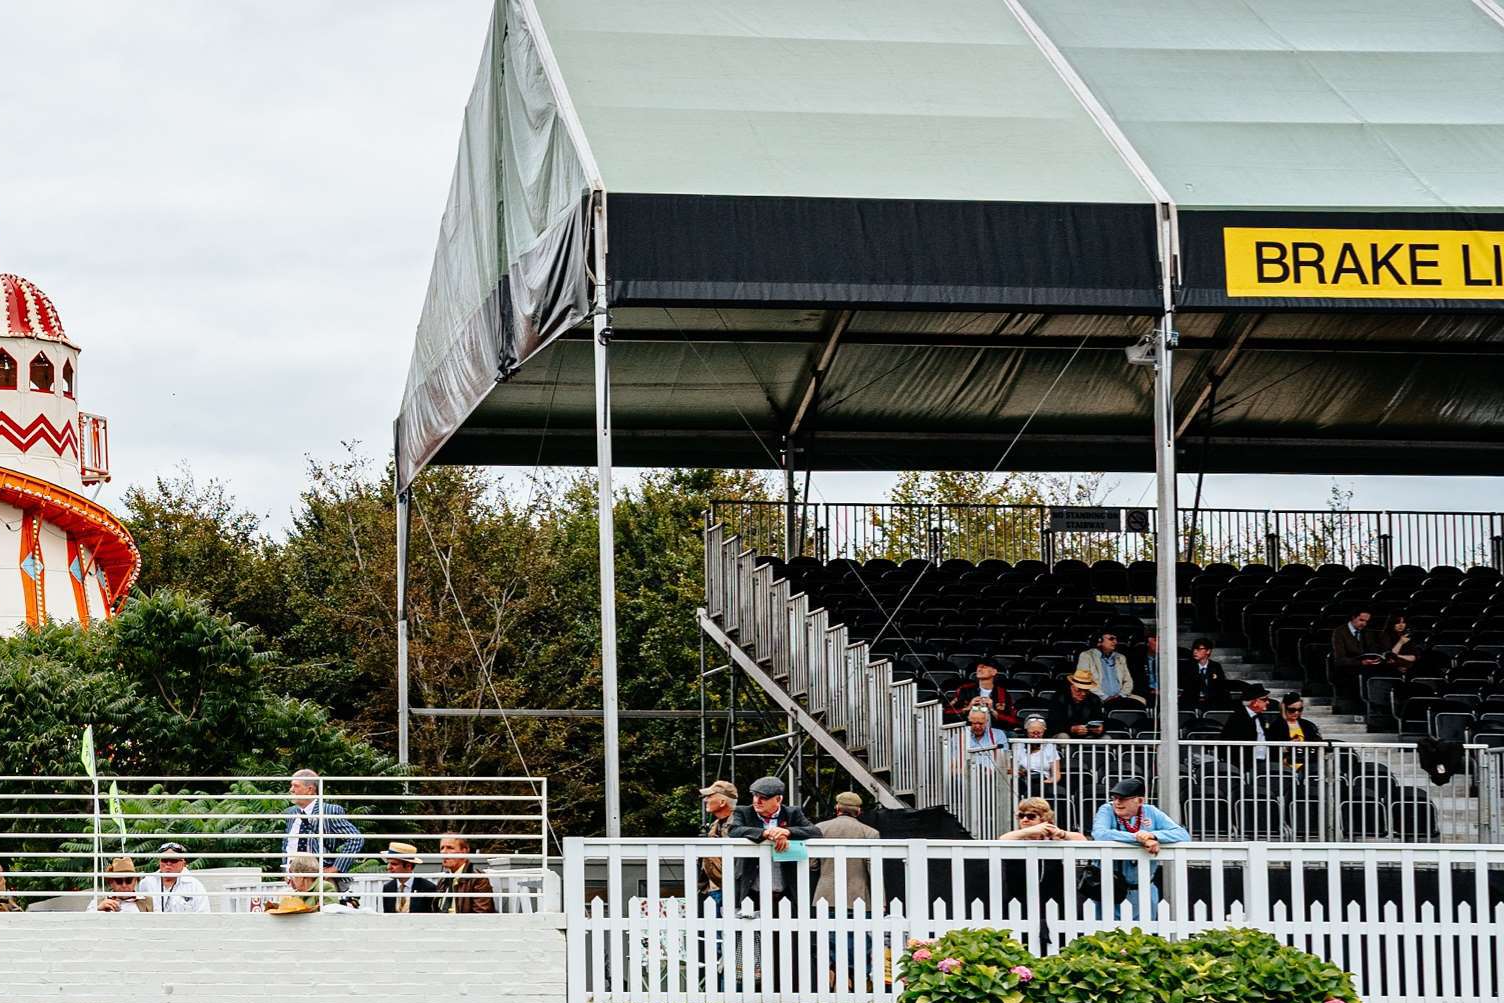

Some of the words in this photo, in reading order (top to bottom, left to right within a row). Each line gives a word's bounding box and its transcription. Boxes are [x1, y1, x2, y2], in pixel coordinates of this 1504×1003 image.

[1255, 240, 1443, 286] BRAKE
[1461, 243, 1503, 287] LI
[1065, 521, 1105, 529] STAIRWAY
